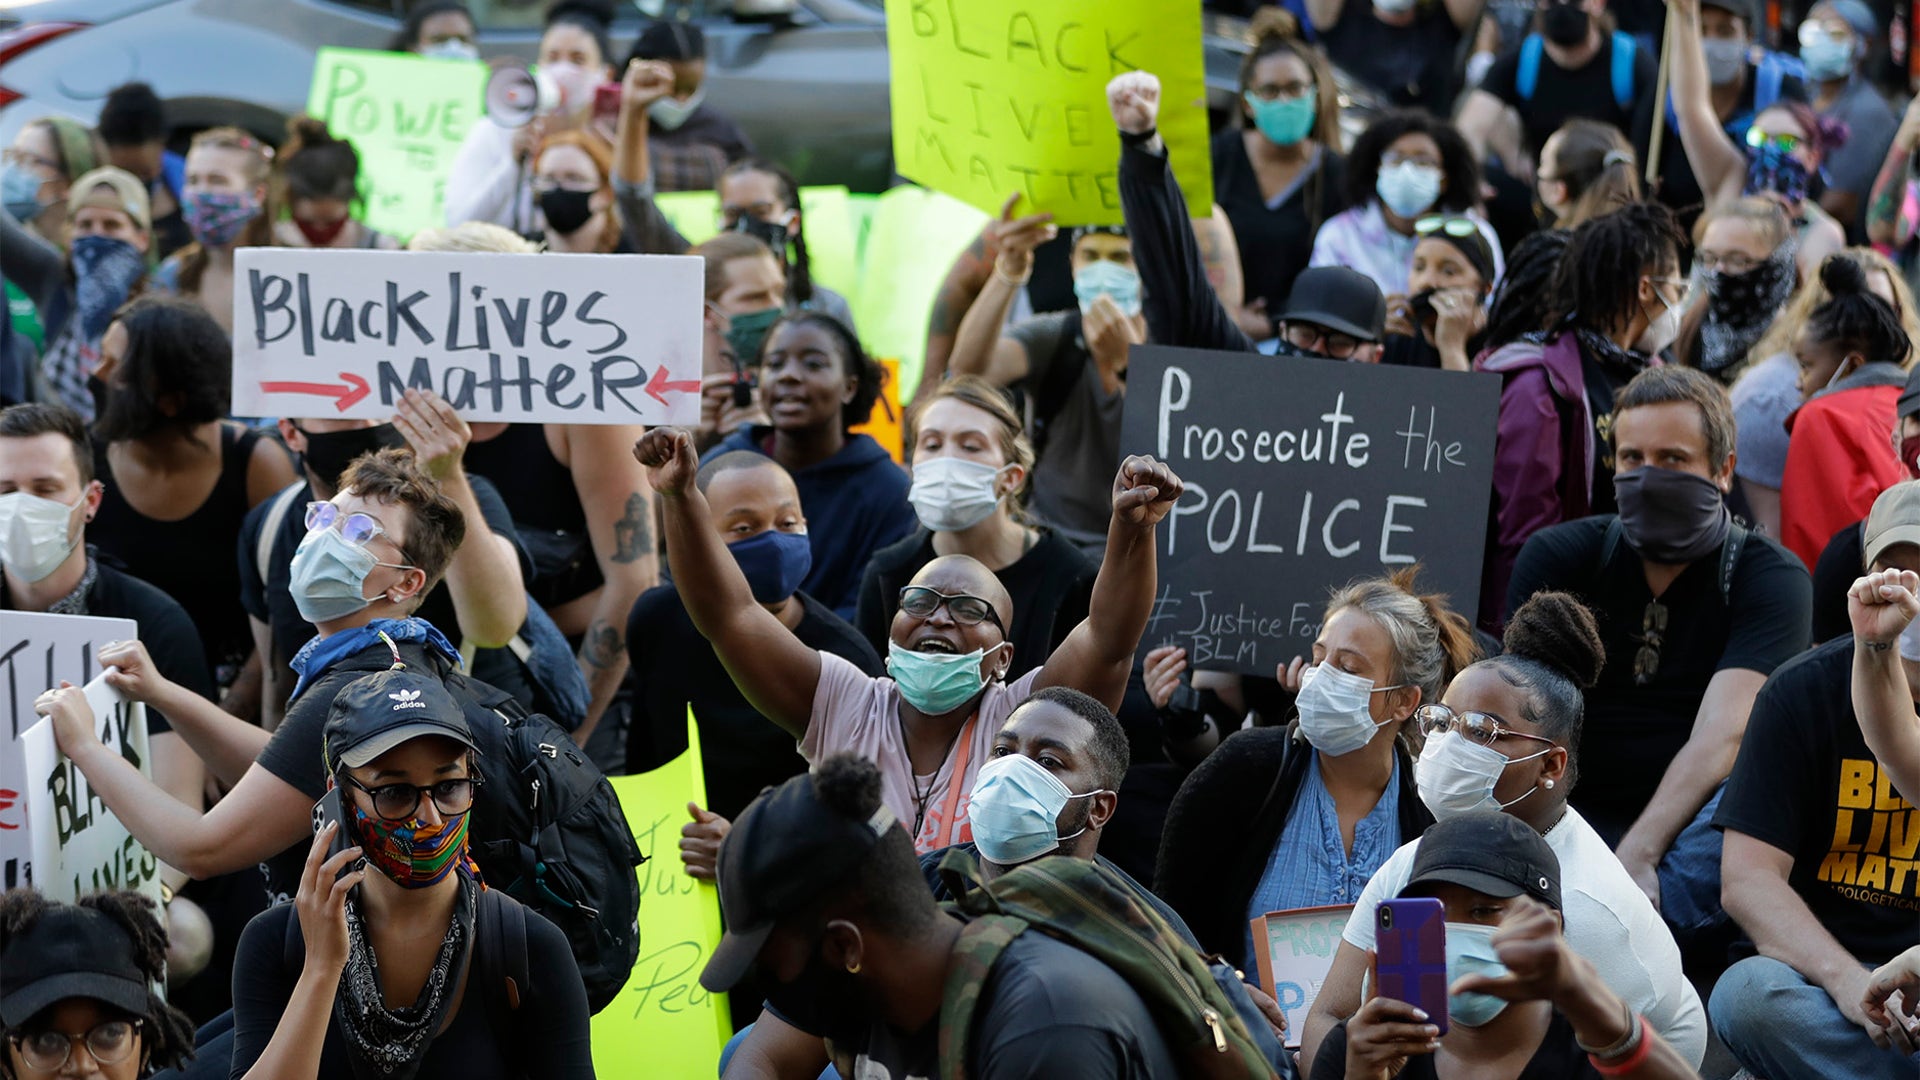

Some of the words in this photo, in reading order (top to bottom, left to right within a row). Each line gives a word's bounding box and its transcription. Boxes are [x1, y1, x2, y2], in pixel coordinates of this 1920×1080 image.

[911, 0, 1140, 73] BLACK
[918, 63, 1094, 147] LIVE
[914, 126, 1119, 210] MATTE
[248, 268, 435, 356] Black
[445, 271, 628, 355] Lives
[1157, 365, 1371, 469] Prosecute
[1395, 404, 1467, 473] the
[1168, 481, 1428, 565] POLICE
[392, 701, 426, 711] adidas
[47, 701, 141, 850] BLAK
[1817, 852, 1920, 898] MAT
[1830, 884, 1920, 912] POLOGETICAL
